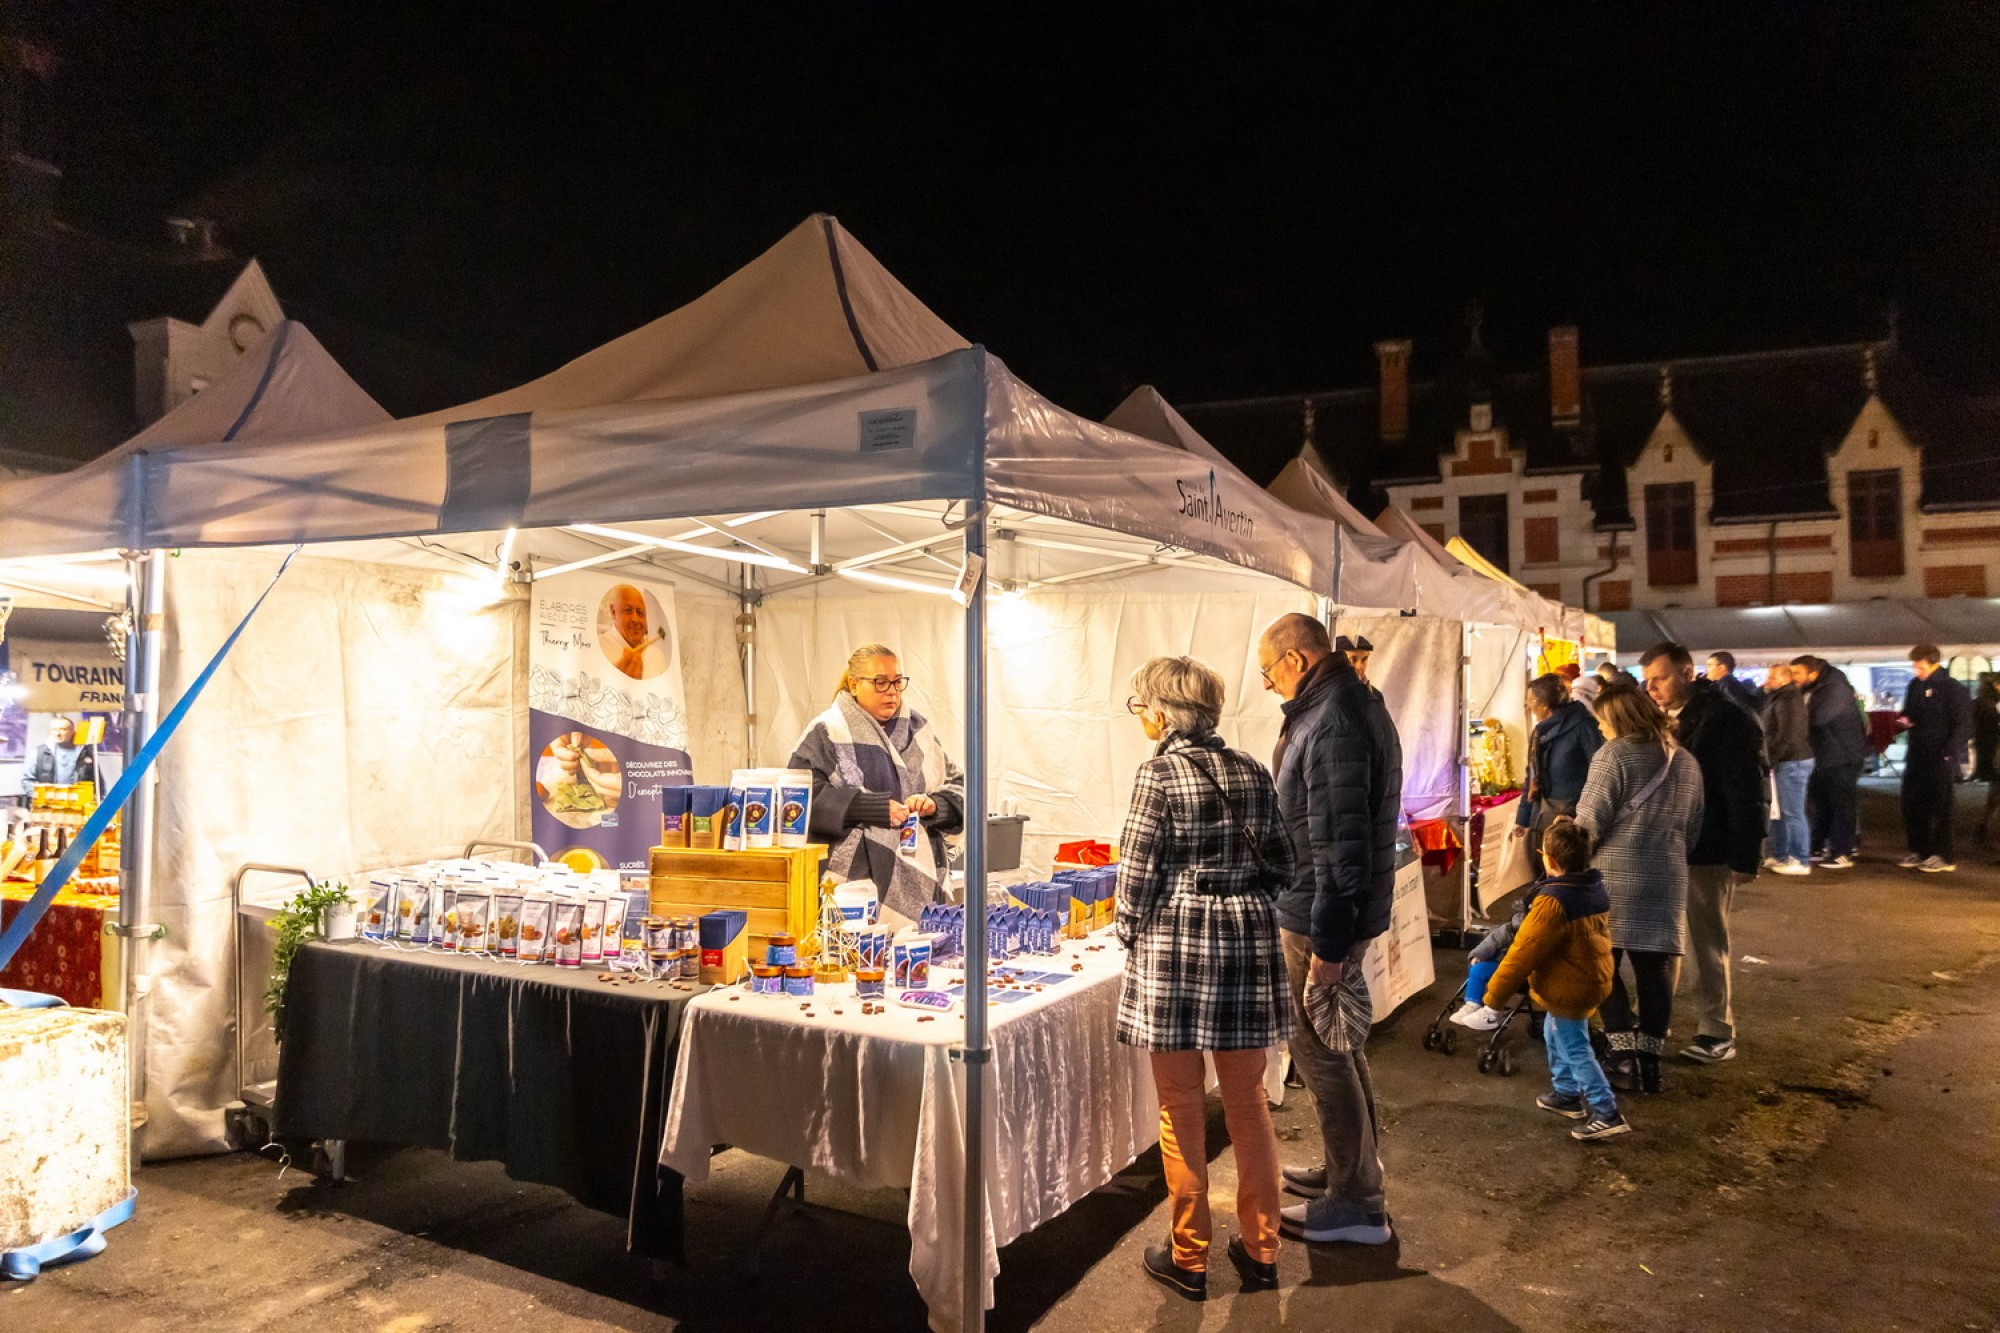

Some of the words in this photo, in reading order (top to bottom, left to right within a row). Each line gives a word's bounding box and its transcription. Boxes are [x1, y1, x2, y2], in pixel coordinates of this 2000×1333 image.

[1176, 479, 1209, 522] Saint
[1214, 494, 1254, 538] Avertin
[539, 630, 570, 651] Thierry
[32, 662, 124, 686] TOURAIN
[80, 691, 124, 704] FRAN
[664, 760, 678, 768] DES
[628, 770, 665, 778] CHOCOLATS
